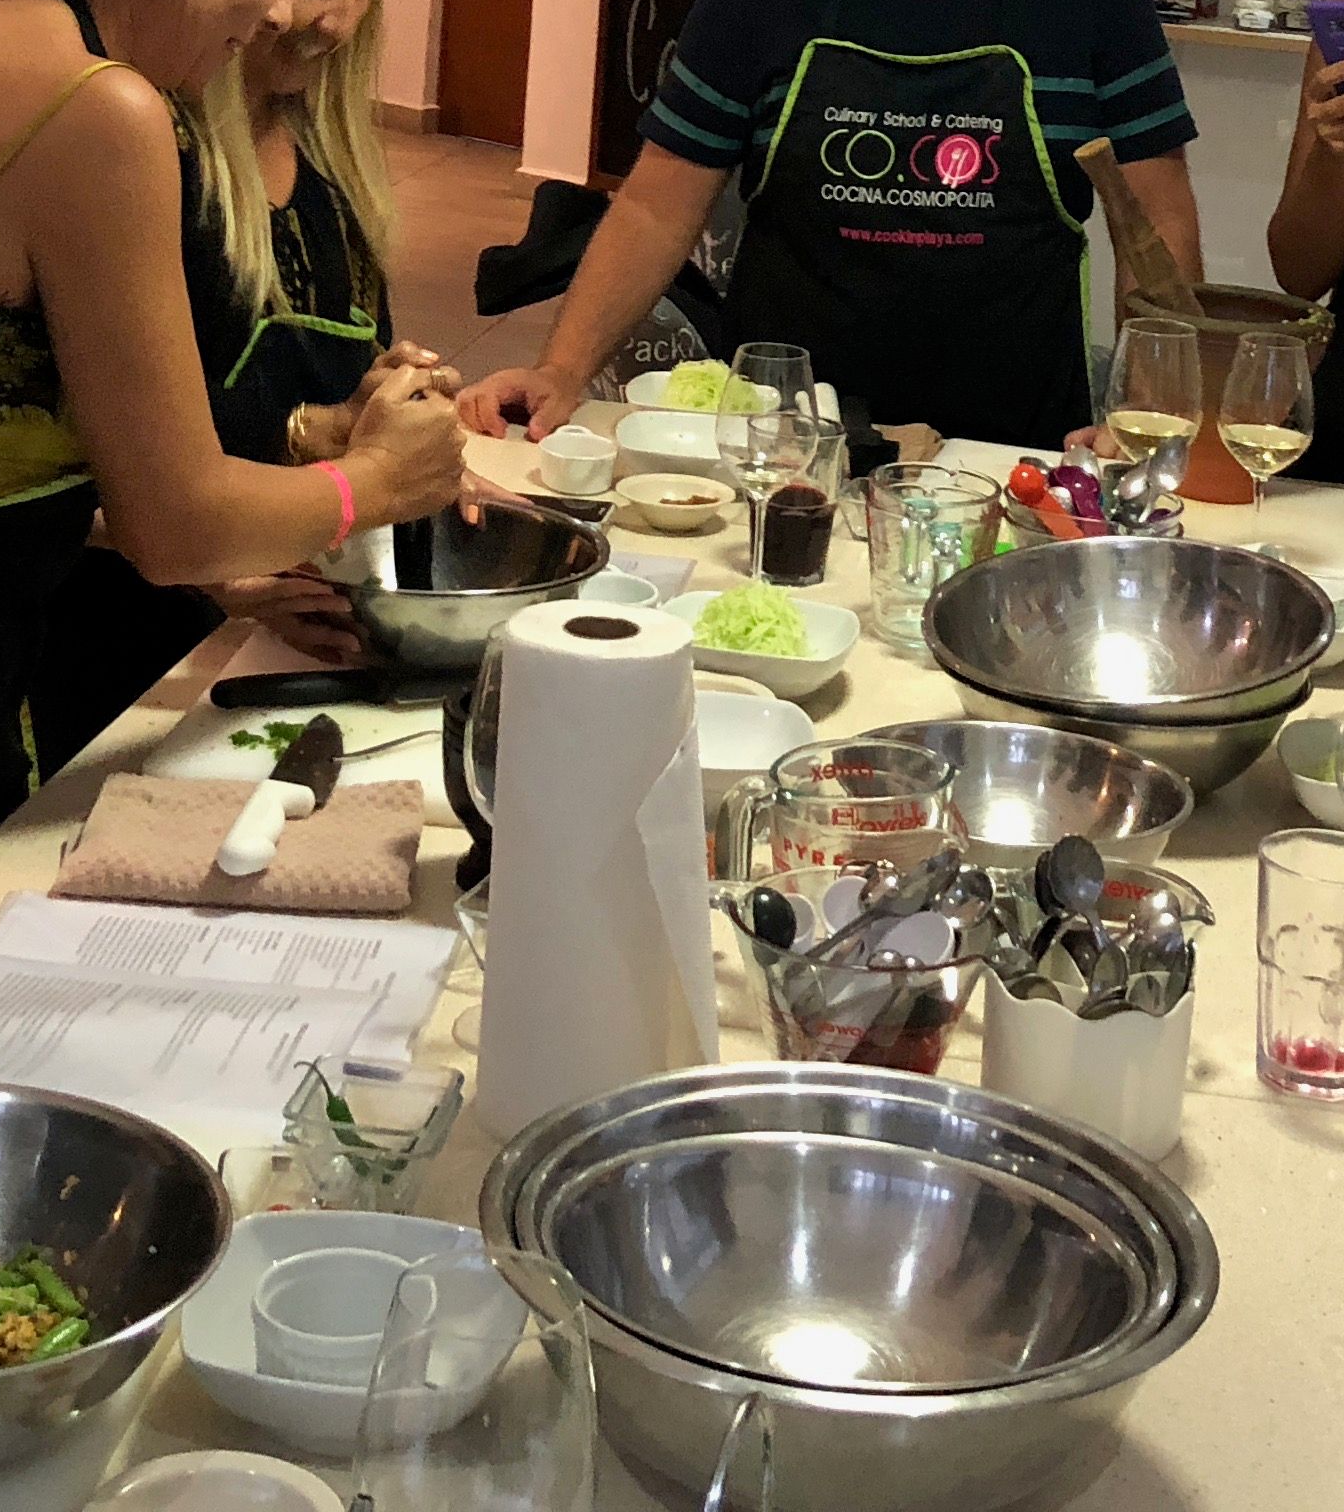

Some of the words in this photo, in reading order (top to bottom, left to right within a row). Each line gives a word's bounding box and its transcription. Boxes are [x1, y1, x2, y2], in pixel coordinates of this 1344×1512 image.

[824, 107, 877, 126] Culinary
[883, 111, 926, 128] School
[930, 114, 942, 128] &
[945, 114, 1003, 133] Catering
[782, 837, 847, 867] PYRE
